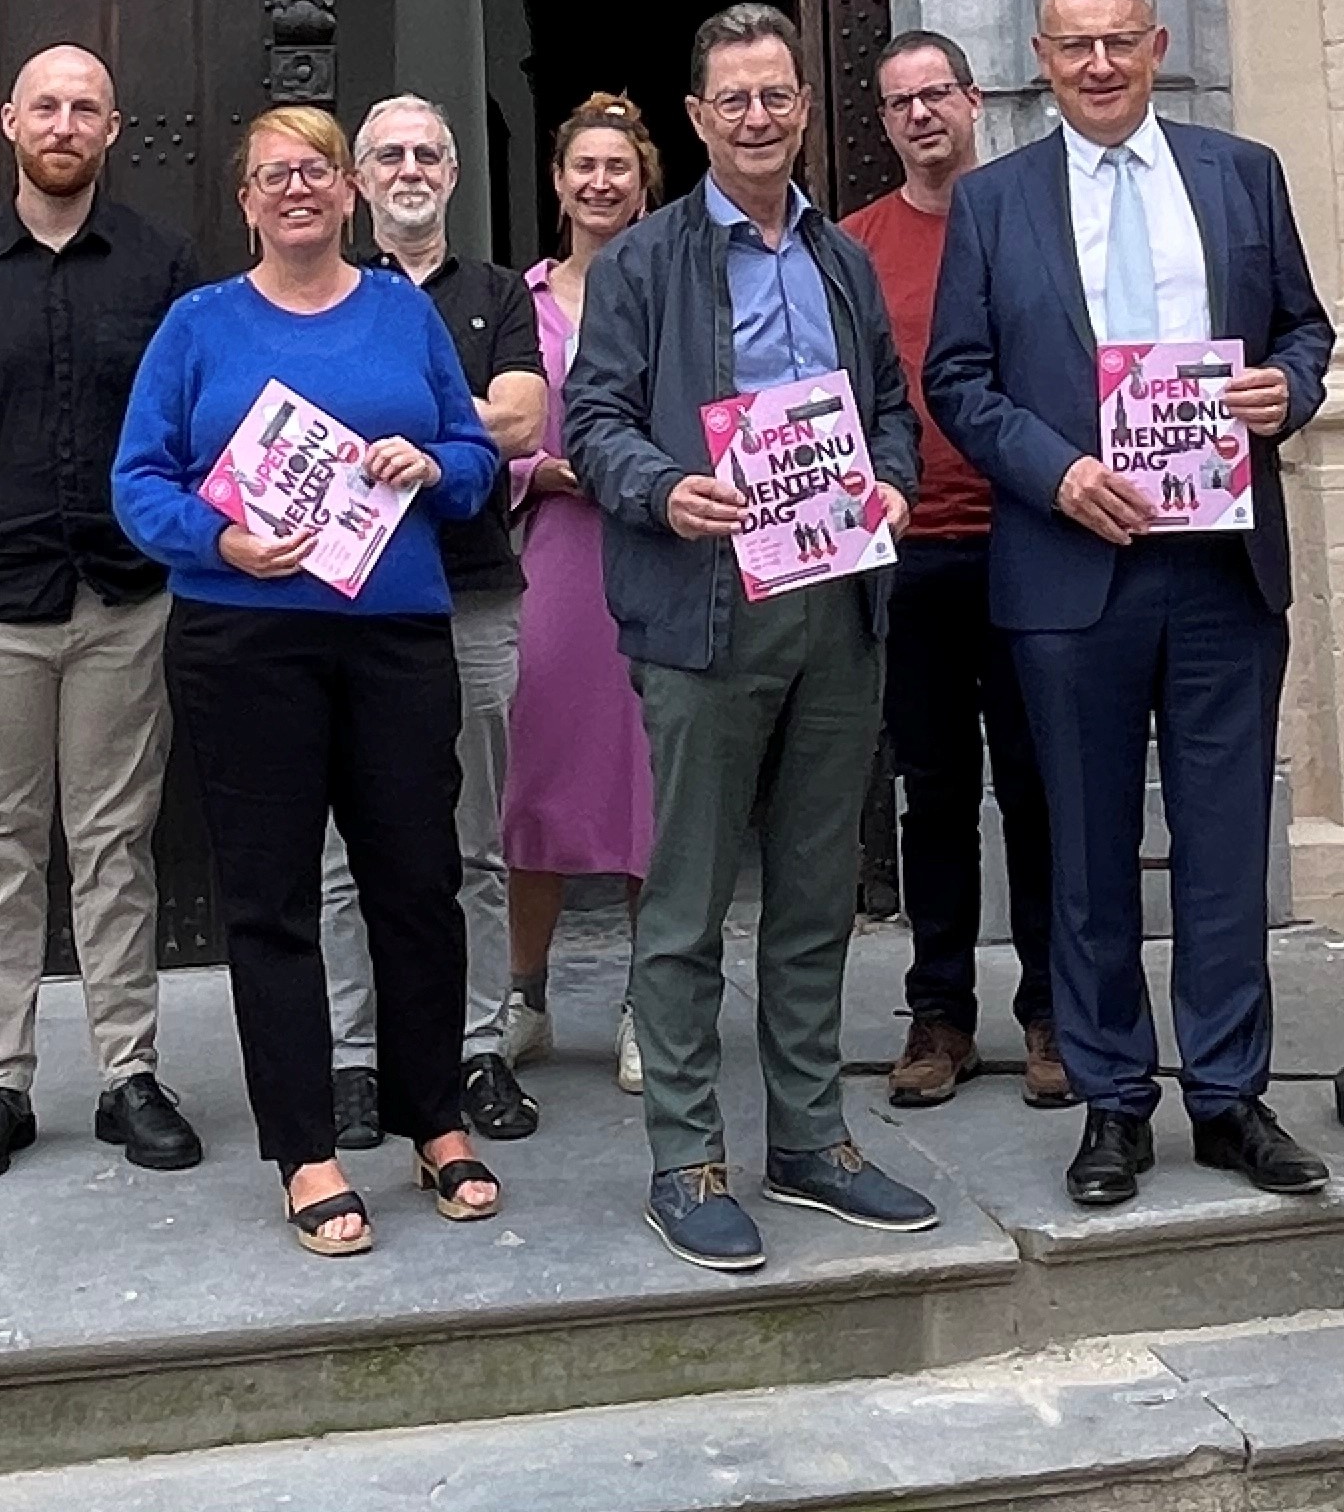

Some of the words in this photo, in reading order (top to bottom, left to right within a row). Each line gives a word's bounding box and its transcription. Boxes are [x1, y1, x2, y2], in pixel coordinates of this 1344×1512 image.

[1111, 424, 1218, 448] MENTEN
[274, 419, 330, 496] MONU
[768, 432, 856, 475] MONU
[1112, 451, 1168, 472] DAG
[741, 503, 796, 535] DAG
